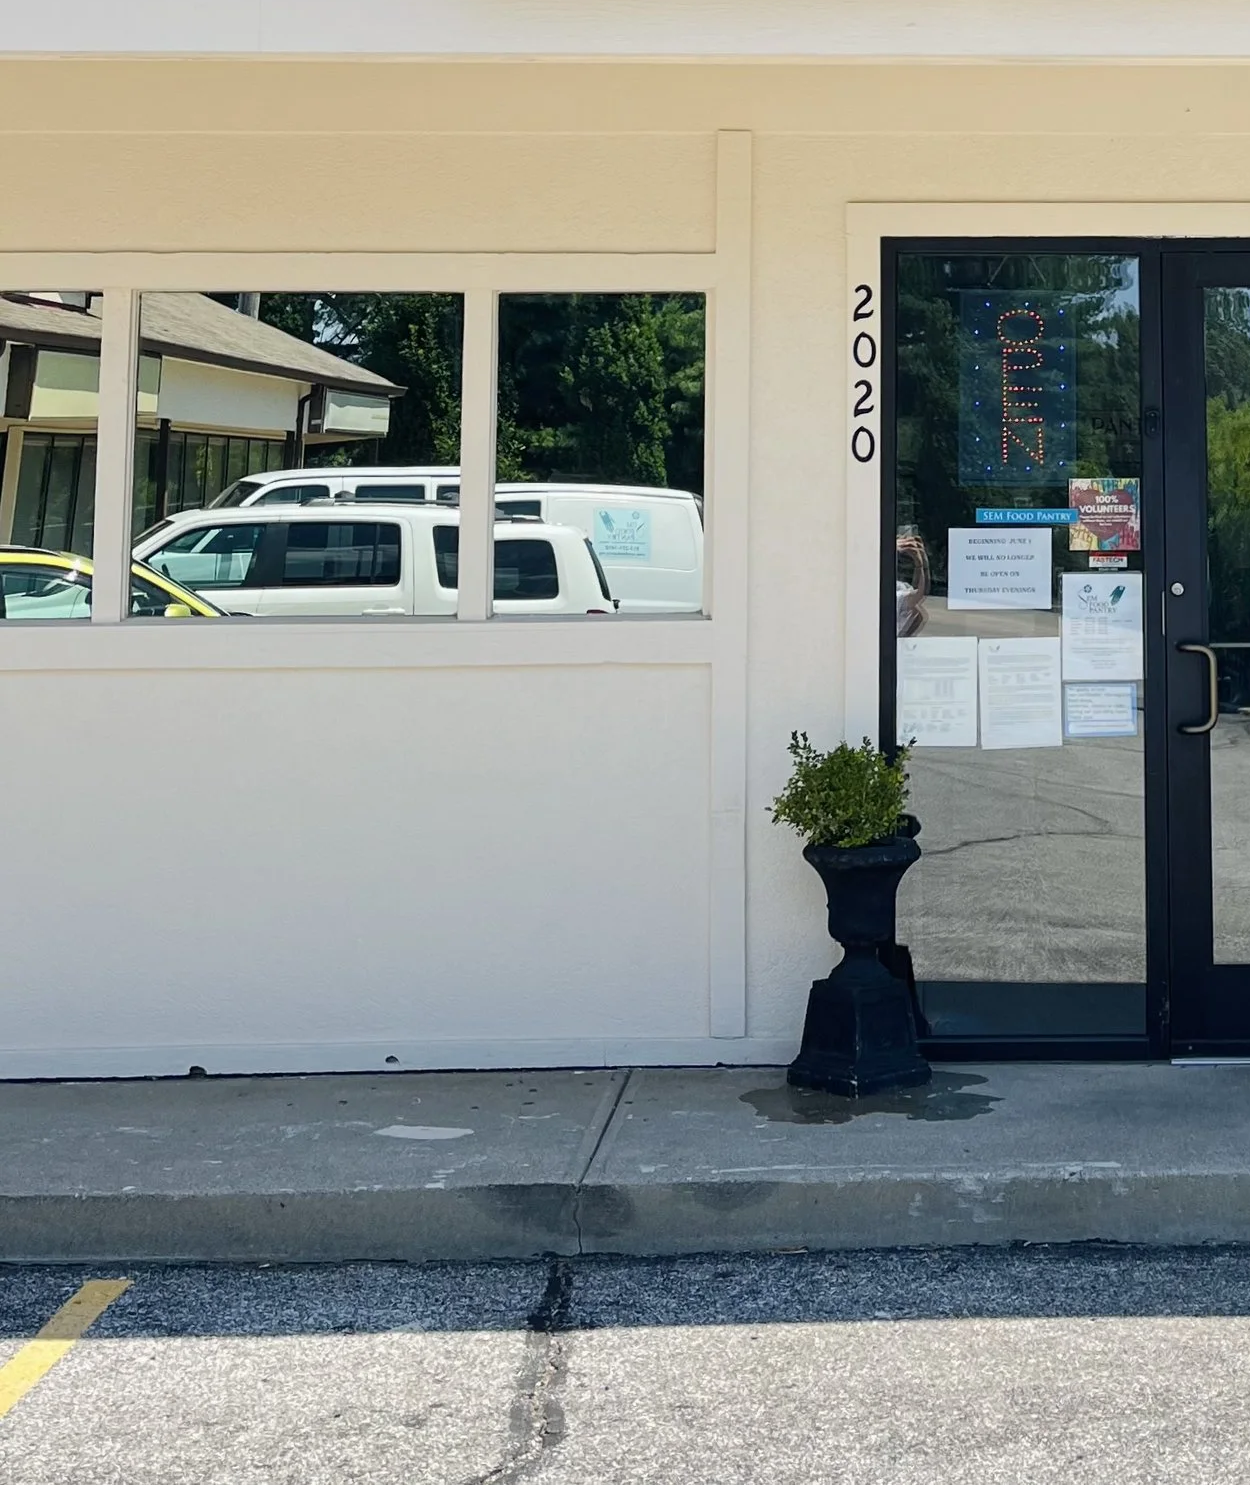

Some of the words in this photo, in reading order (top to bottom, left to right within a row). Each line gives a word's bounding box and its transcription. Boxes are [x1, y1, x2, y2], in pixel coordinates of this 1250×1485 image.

[851, 283, 877, 463] 2020
[996, 308, 1045, 466] OPEN
[1091, 416, 1140, 435] PAN
[1095, 495, 1119, 504] 100%
[983, 511, 1003, 521] SEM
[1006, 512, 1034, 521] FOOD
[1036, 512, 1072, 521] PANTRY
[1079, 504, 1136, 514] VOLUNTEERS
